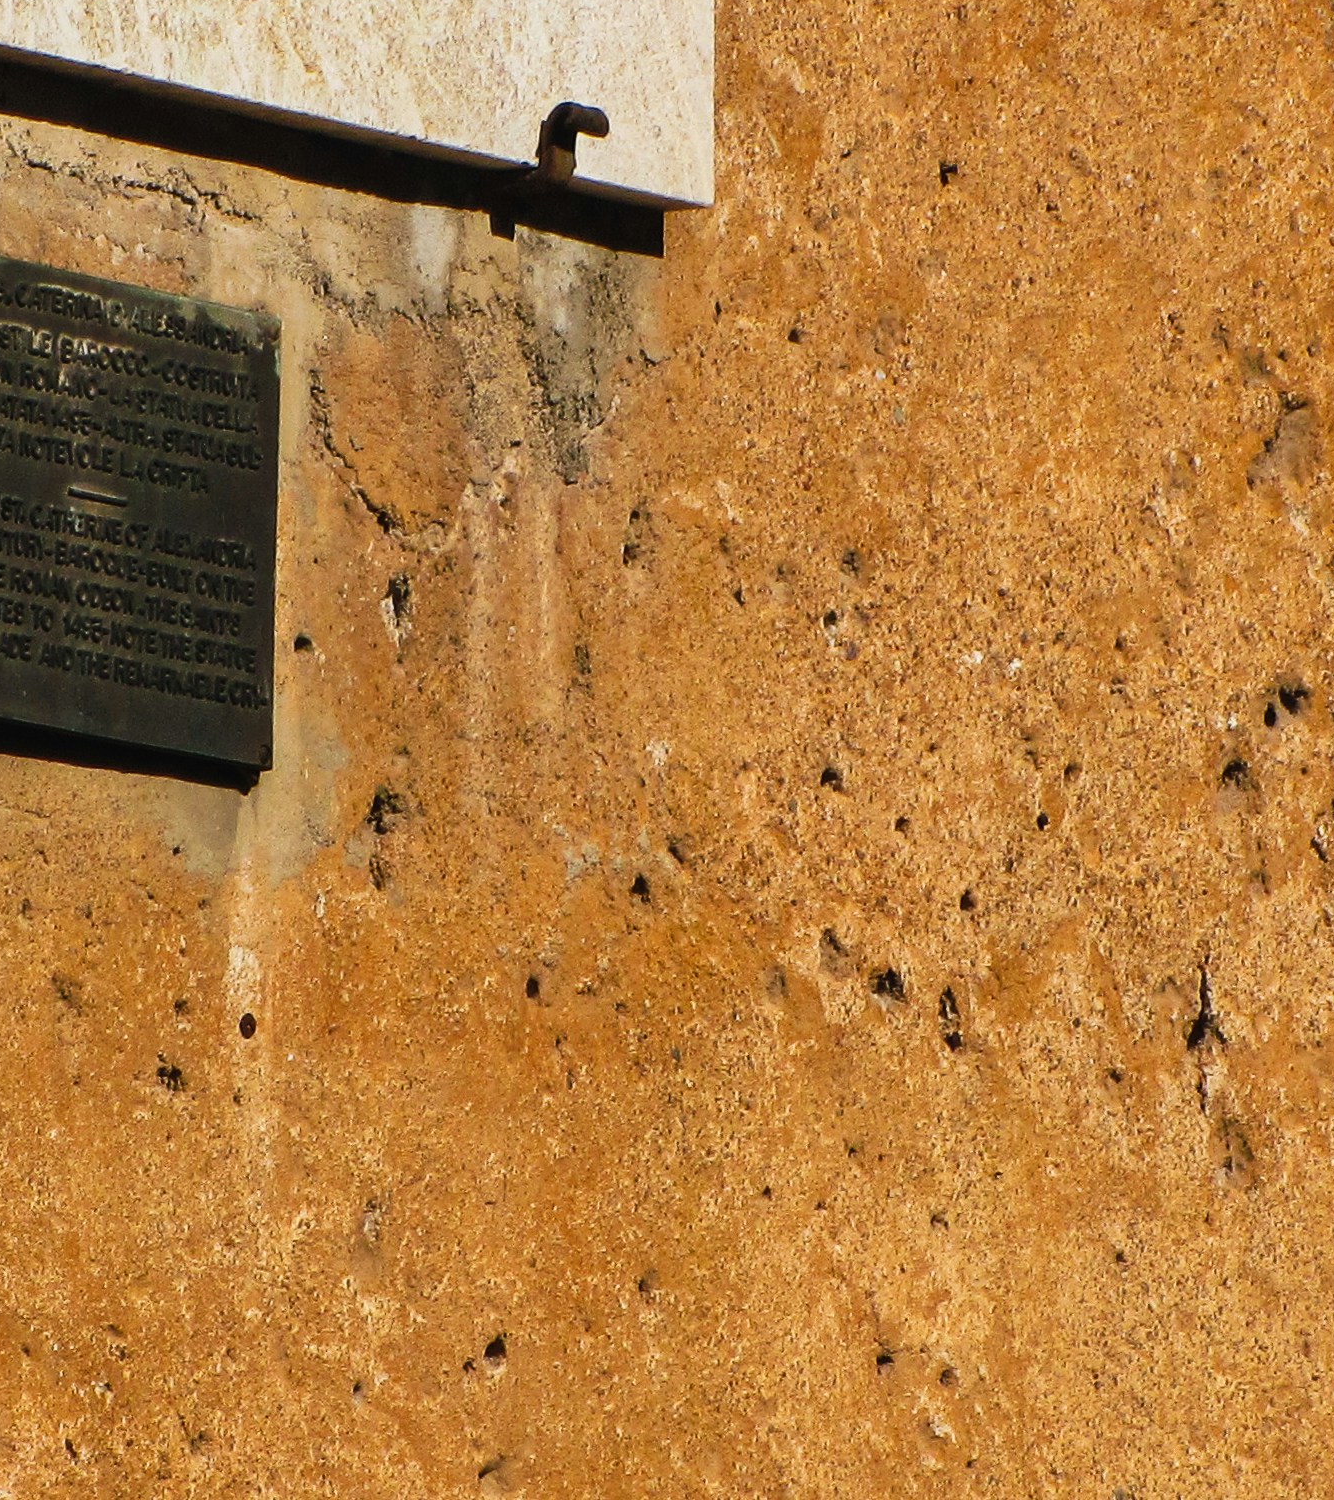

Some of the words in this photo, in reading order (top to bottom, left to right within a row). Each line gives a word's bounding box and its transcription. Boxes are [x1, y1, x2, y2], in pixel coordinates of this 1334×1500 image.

[18, 432, 115, 474] NOTEVOLE
[147, 458, 209, 494] CRIPTA
[124, 521, 149, 549] OF
[152, 527, 257, 571] ALEXANDRIA
[10, 566, 70, 603] ROMAN
[222, 574, 256, 607] THE
[30, 602, 54, 633] TO
[159, 631, 192, 663] THE
[194, 638, 256, 673] STATUE
[38, 643, 75, 672] AND
[77, 649, 111, 679] THE
[113, 656, 228, 702] REMARKABLE
